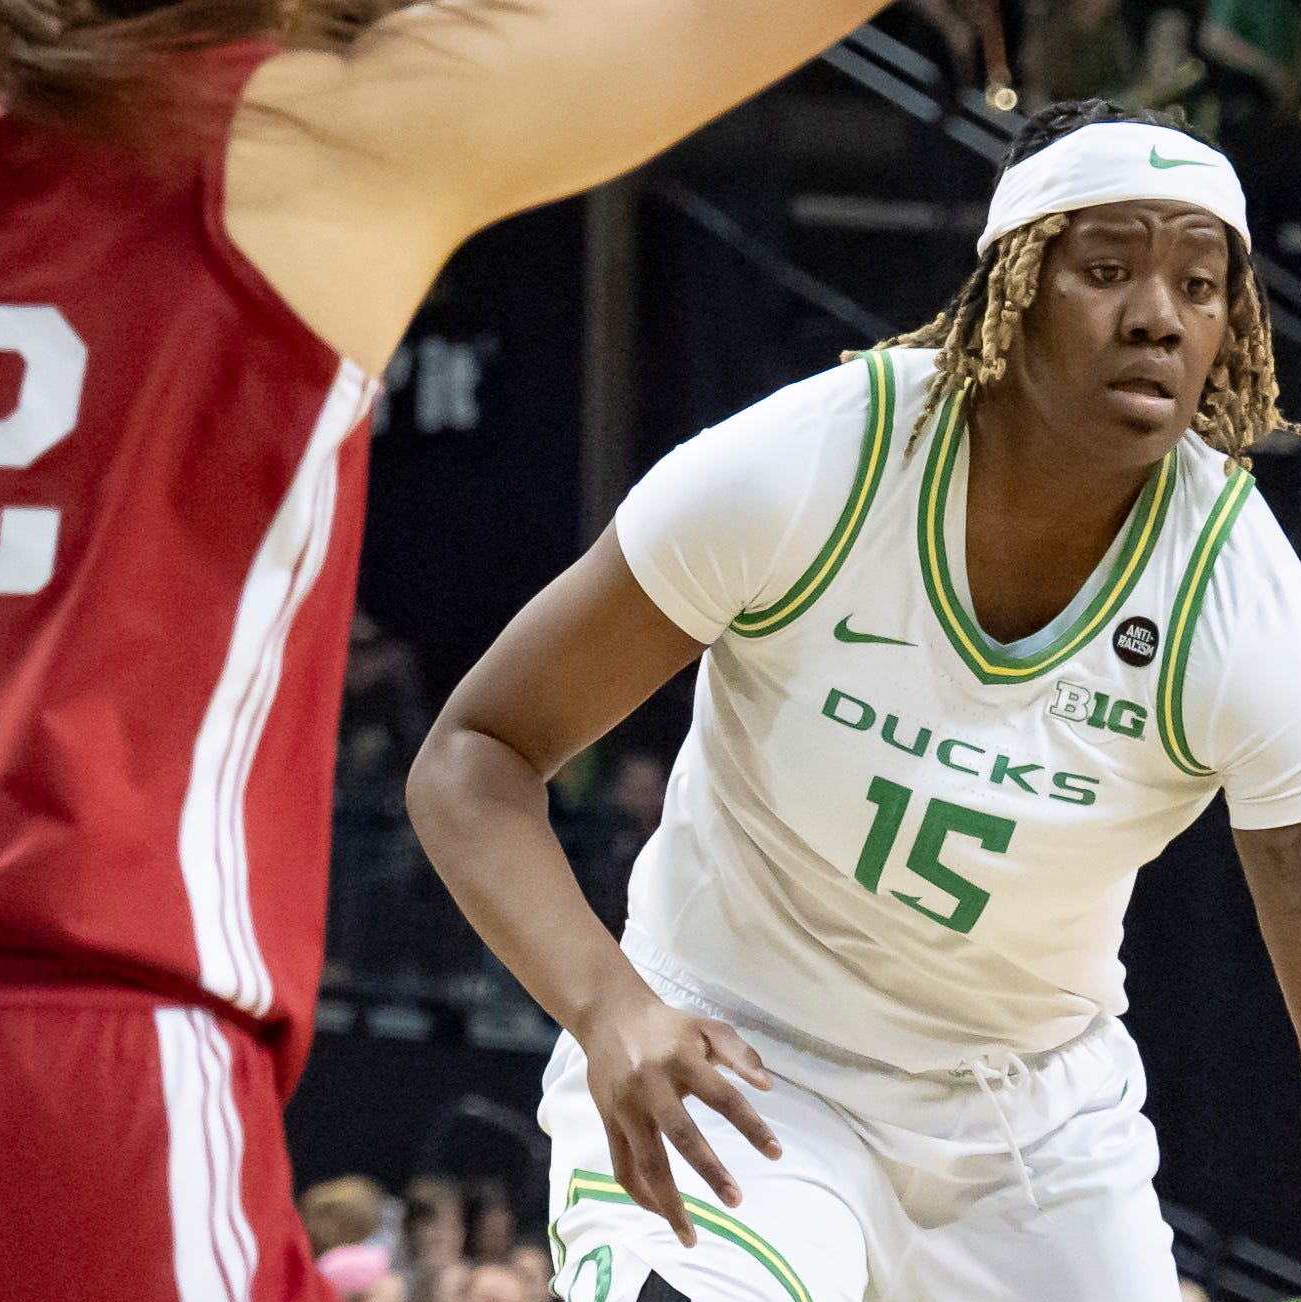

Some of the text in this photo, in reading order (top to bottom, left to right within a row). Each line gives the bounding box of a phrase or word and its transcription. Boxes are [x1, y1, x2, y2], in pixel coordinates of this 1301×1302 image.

[1117, 634, 1155, 658] RACISM
[821, 687, 1100, 806] DUCKS
[854, 775, 1017, 935] 15
